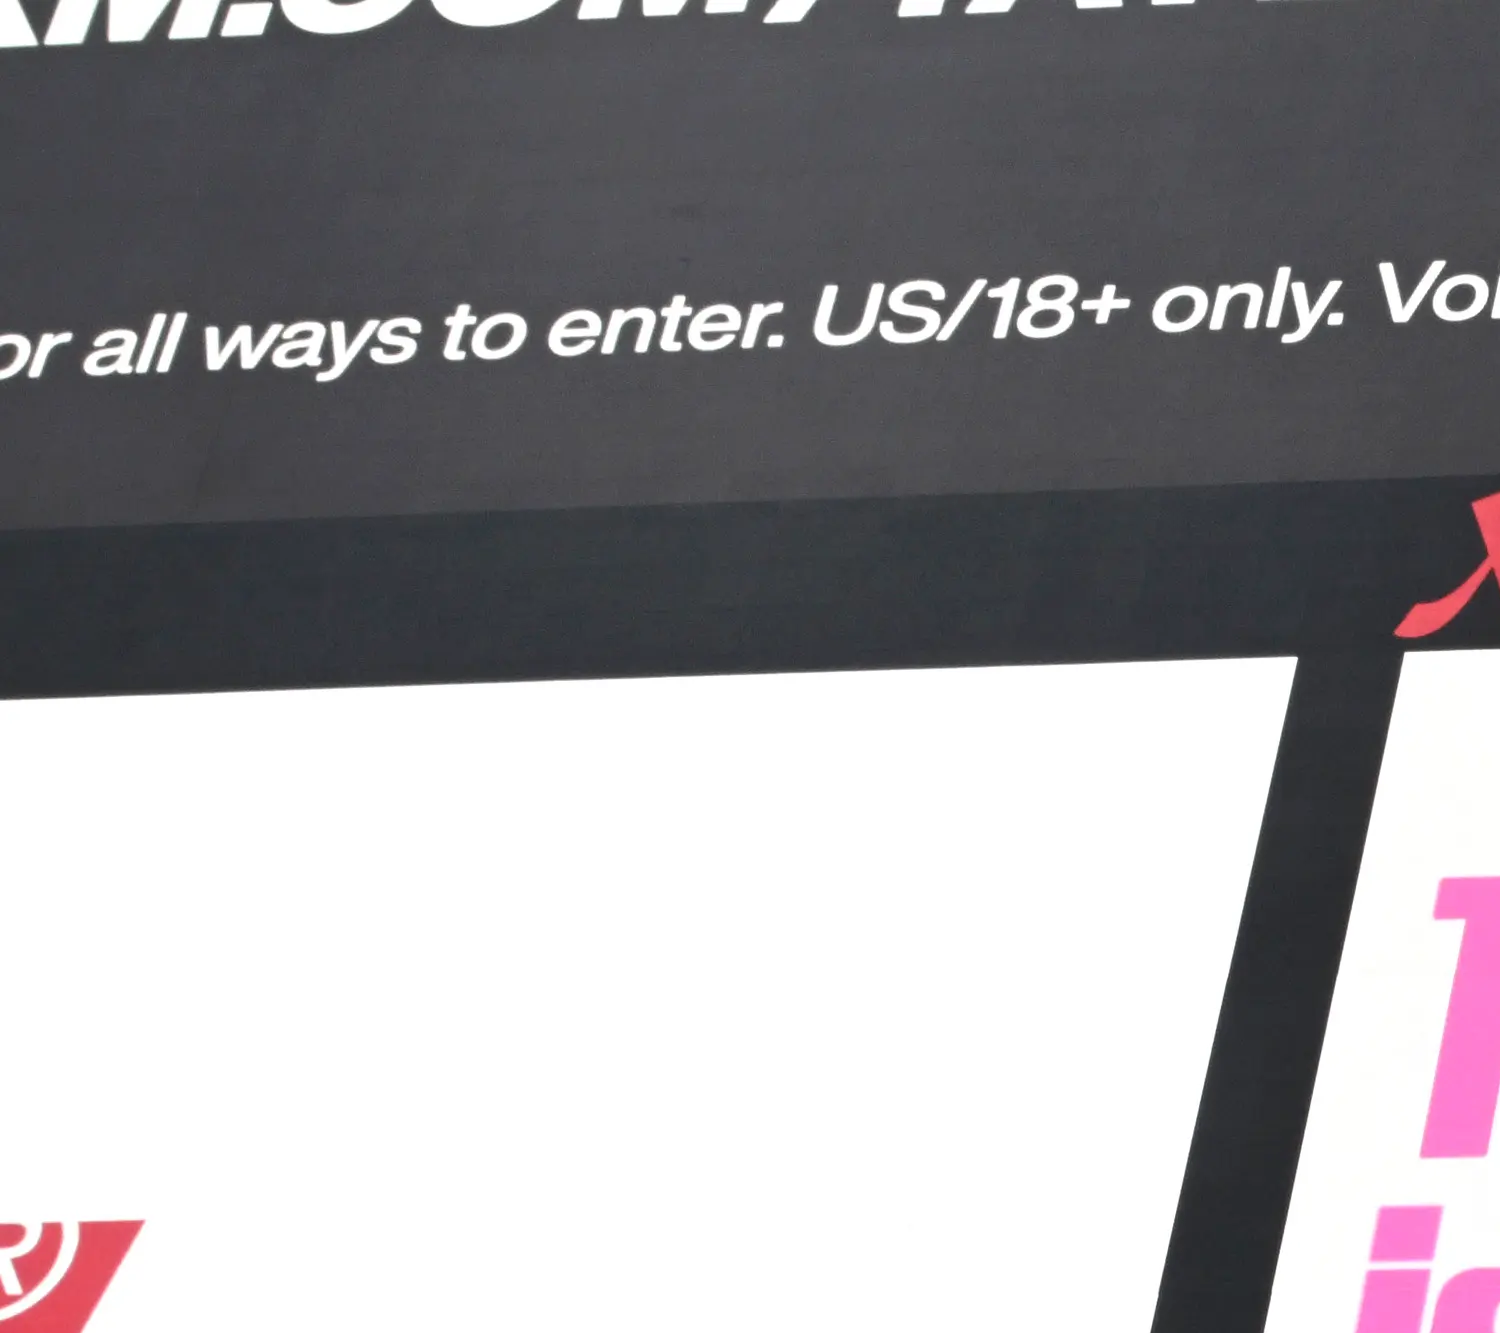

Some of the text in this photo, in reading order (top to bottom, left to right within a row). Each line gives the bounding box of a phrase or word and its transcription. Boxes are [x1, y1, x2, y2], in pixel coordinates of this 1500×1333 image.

[83, 311, 188, 377] all
[205, 316, 423, 383] ways
[443, 303, 528, 361] to
[548, 294, 785, 357] enter.
[813, 273, 1131, 347] US/18+
[1152, 265, 1345, 344] only.
